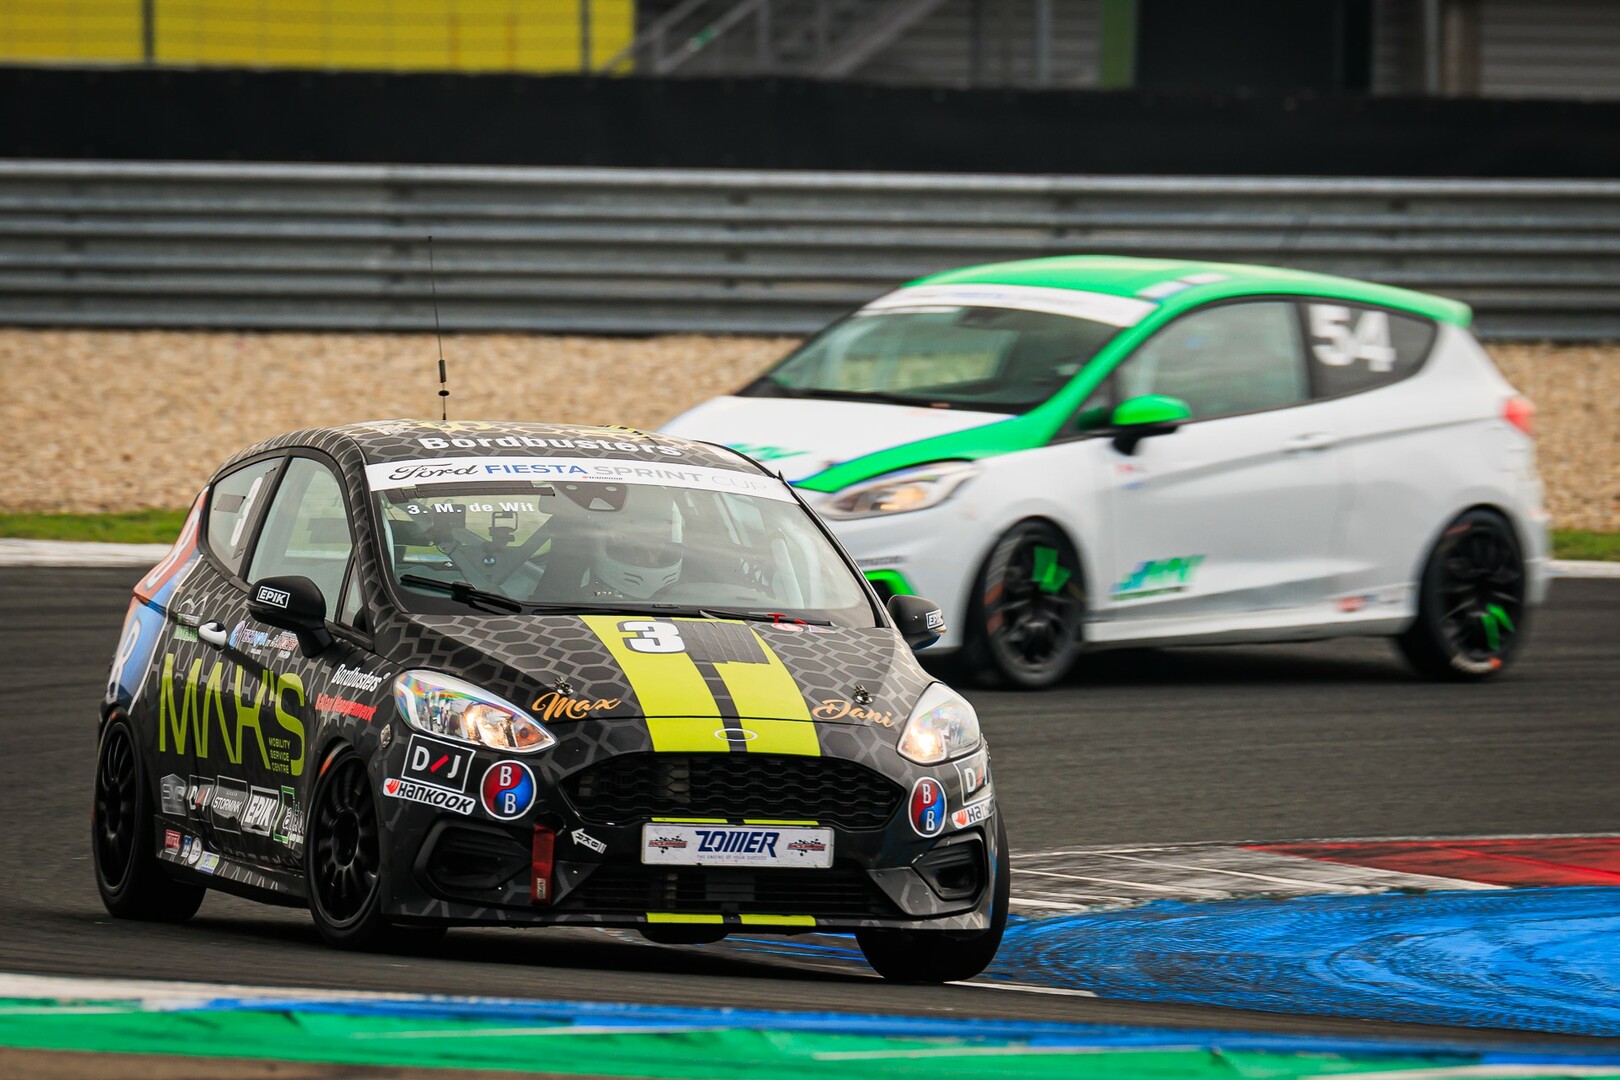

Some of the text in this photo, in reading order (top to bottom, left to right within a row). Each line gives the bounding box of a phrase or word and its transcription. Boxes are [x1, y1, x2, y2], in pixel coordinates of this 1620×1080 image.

[1308, 304, 1396, 372] 54
[418, 436, 683, 456] Bordbusters
[388, 463, 767, 490] Ford FIESTA SPRINT CUP
[407, 502, 535, 515] 3. M. de Wit
[260, 589, 287, 605] EPIK
[617, 620, 686, 655] 3
[331, 663, 383, 692] Bordbusters
[531, 691, 622, 721] Max
[811, 699, 898, 728] Dani
[268, 736, 291, 749] MOBILITY
[270, 750, 290, 762] SERVICE
[271, 762, 290, 774] CENTRE
[499, 765, 512, 787] B
[504, 793, 516, 814] B
[922, 783, 932, 804] B
[245, 795, 277, 826] EPIK
[926, 811, 935, 831] B
[695, 830, 780, 858] ZOMER
